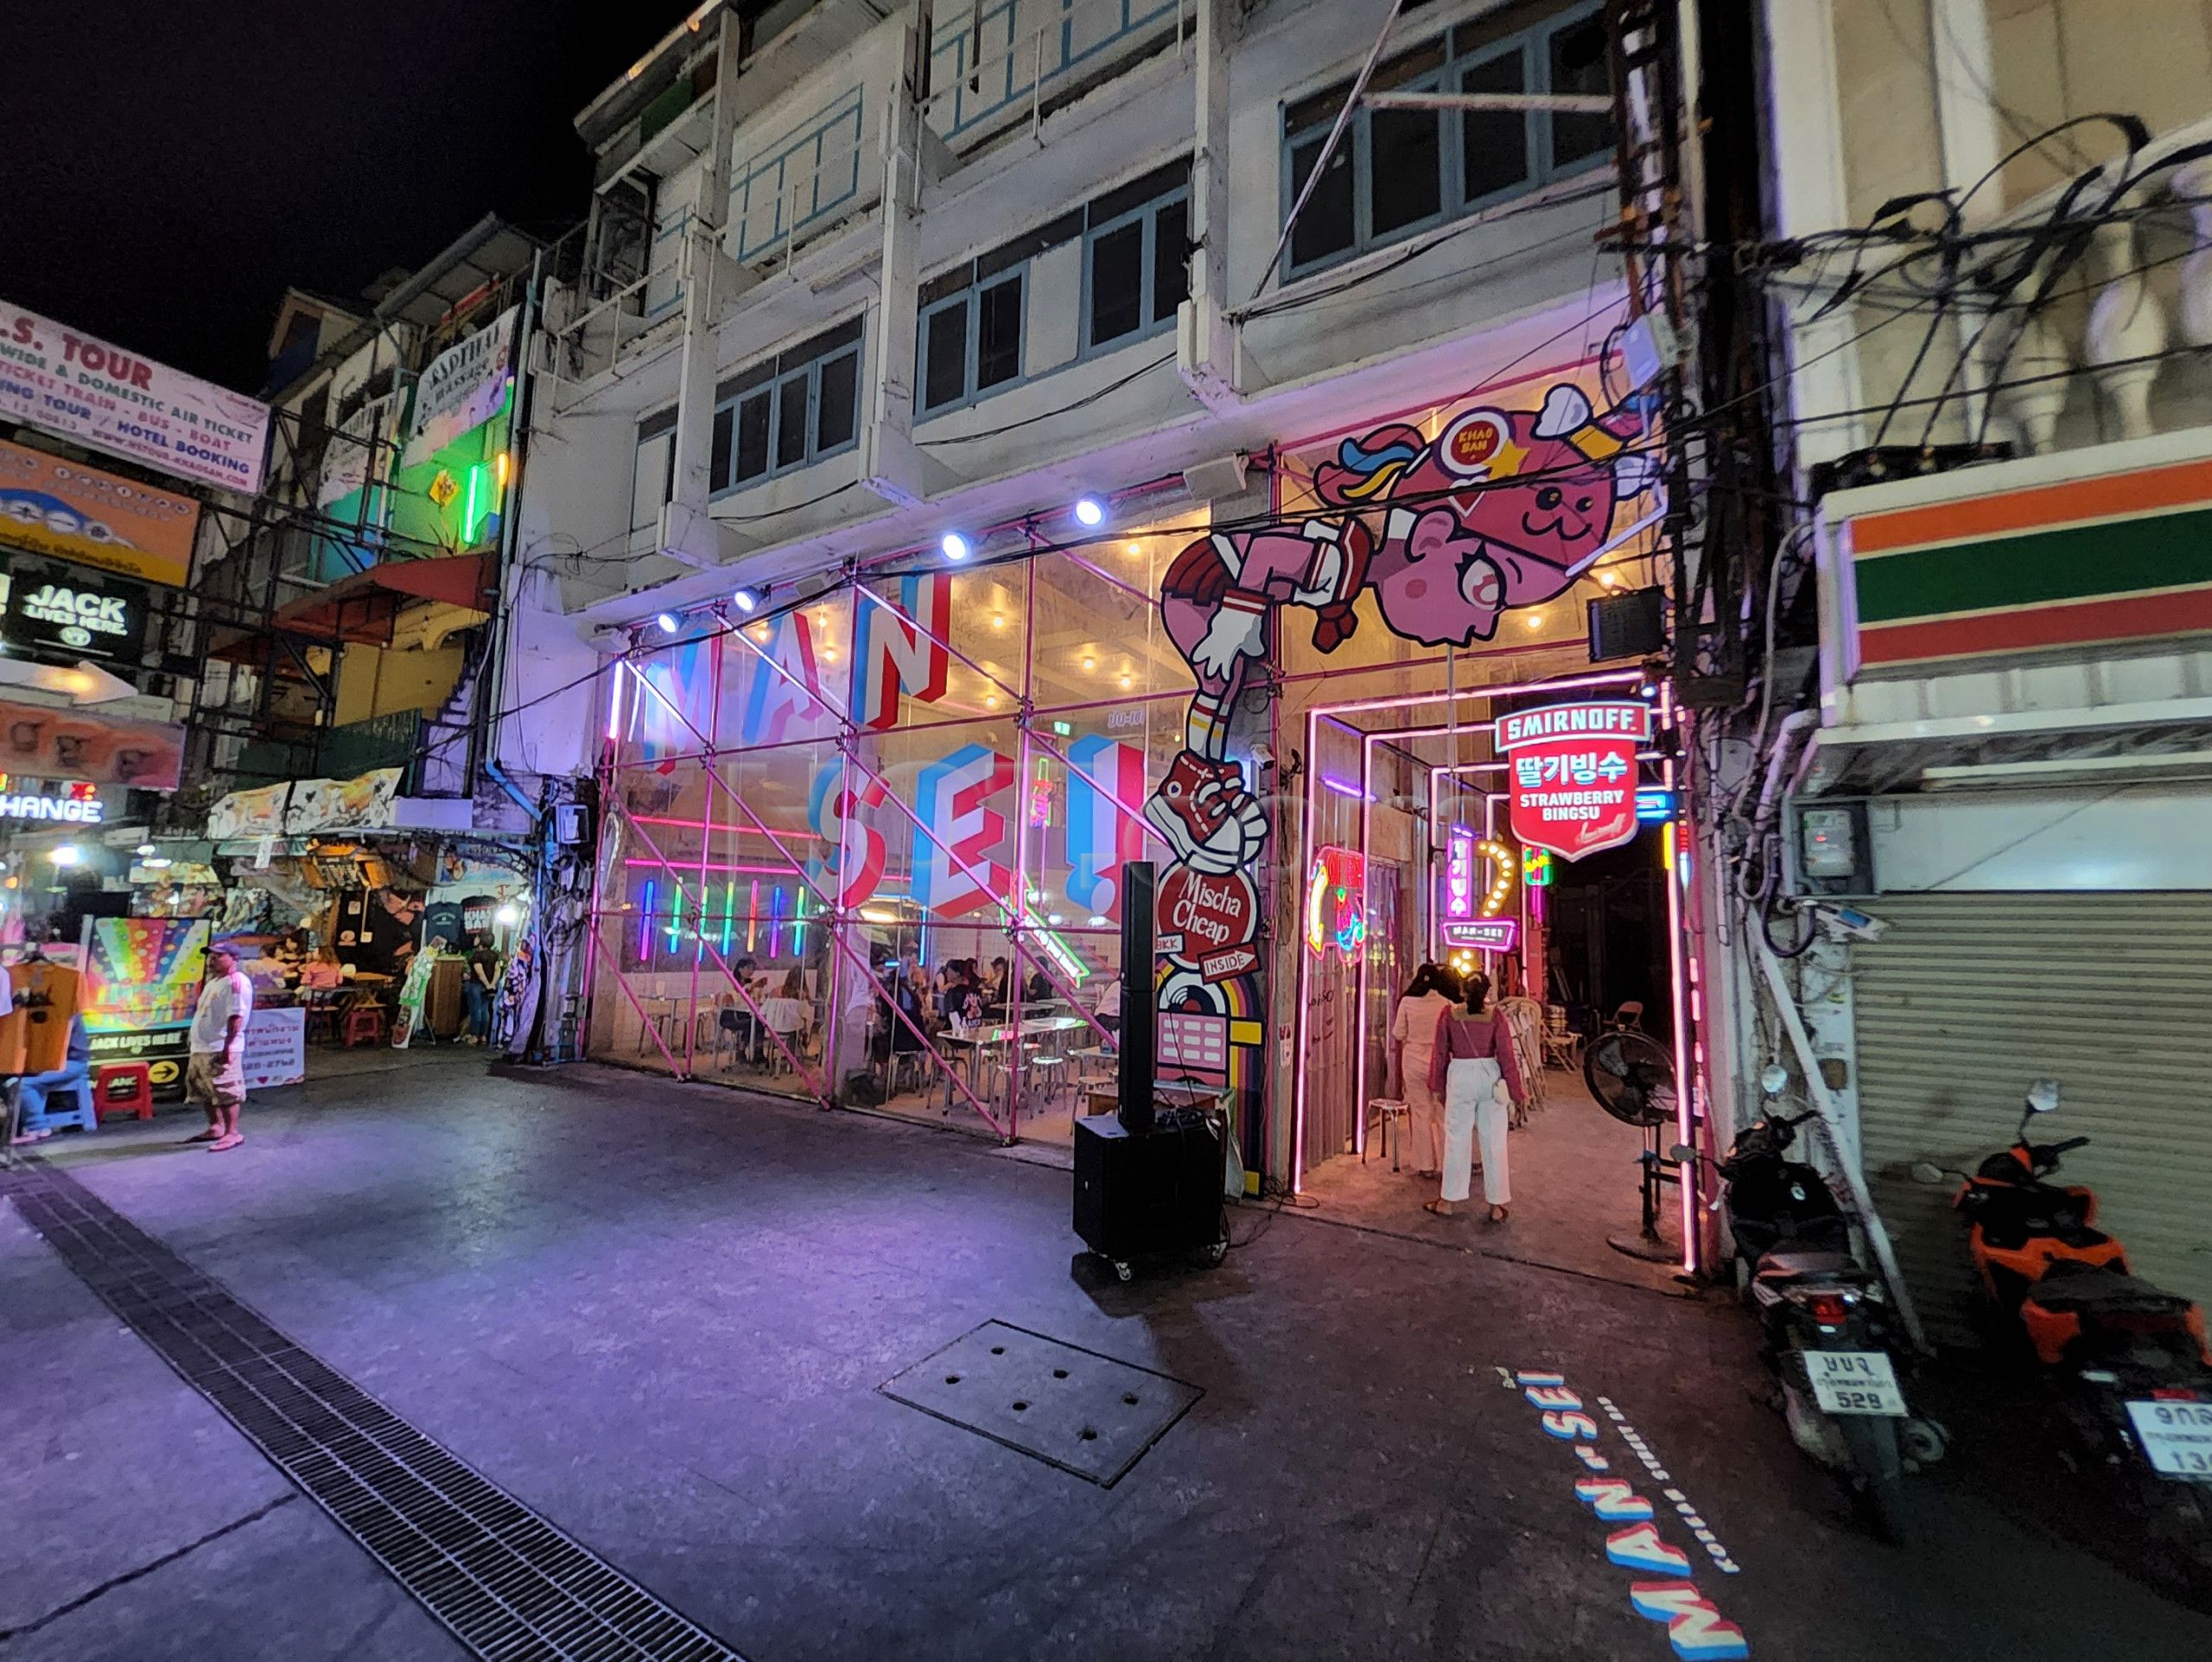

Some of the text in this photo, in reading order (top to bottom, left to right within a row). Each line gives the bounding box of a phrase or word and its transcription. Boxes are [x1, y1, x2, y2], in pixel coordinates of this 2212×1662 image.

[62, 332, 153, 392] TOUR
[64, 383, 116, 411] TRAIN
[137, 411, 169, 430] BUS
[189, 429, 231, 451] BOAT
[78, 372, 165, 413] DOMESTIC
[170, 406, 199, 424] AIR
[204, 417, 253, 444] TICKET
[44, 393, 92, 420] TOUR
[117, 418, 168, 448] HOTEL
[175, 440, 250, 474] BOOKING
[1459, 428, 1493, 443] KHAO
[1461, 440, 1488, 454] SAN
[22, 584, 127, 623] JACK
[1507, 708, 1636, 741] SMIRNOFF
[1516, 751, 1628, 788] 딸기빙수
[1520, 790, 1624, 808] STRAWBERRY
[1542, 806, 1600, 822] BINGSU
[1178, 870, 1242, 919] Mischa
[1172, 899, 1230, 946] Cheap
[1205, 953, 1246, 971] INSIDE
[1618, 1424, 1670, 1481] STREET
[1663, 1487, 1741, 1573] KOREAN
